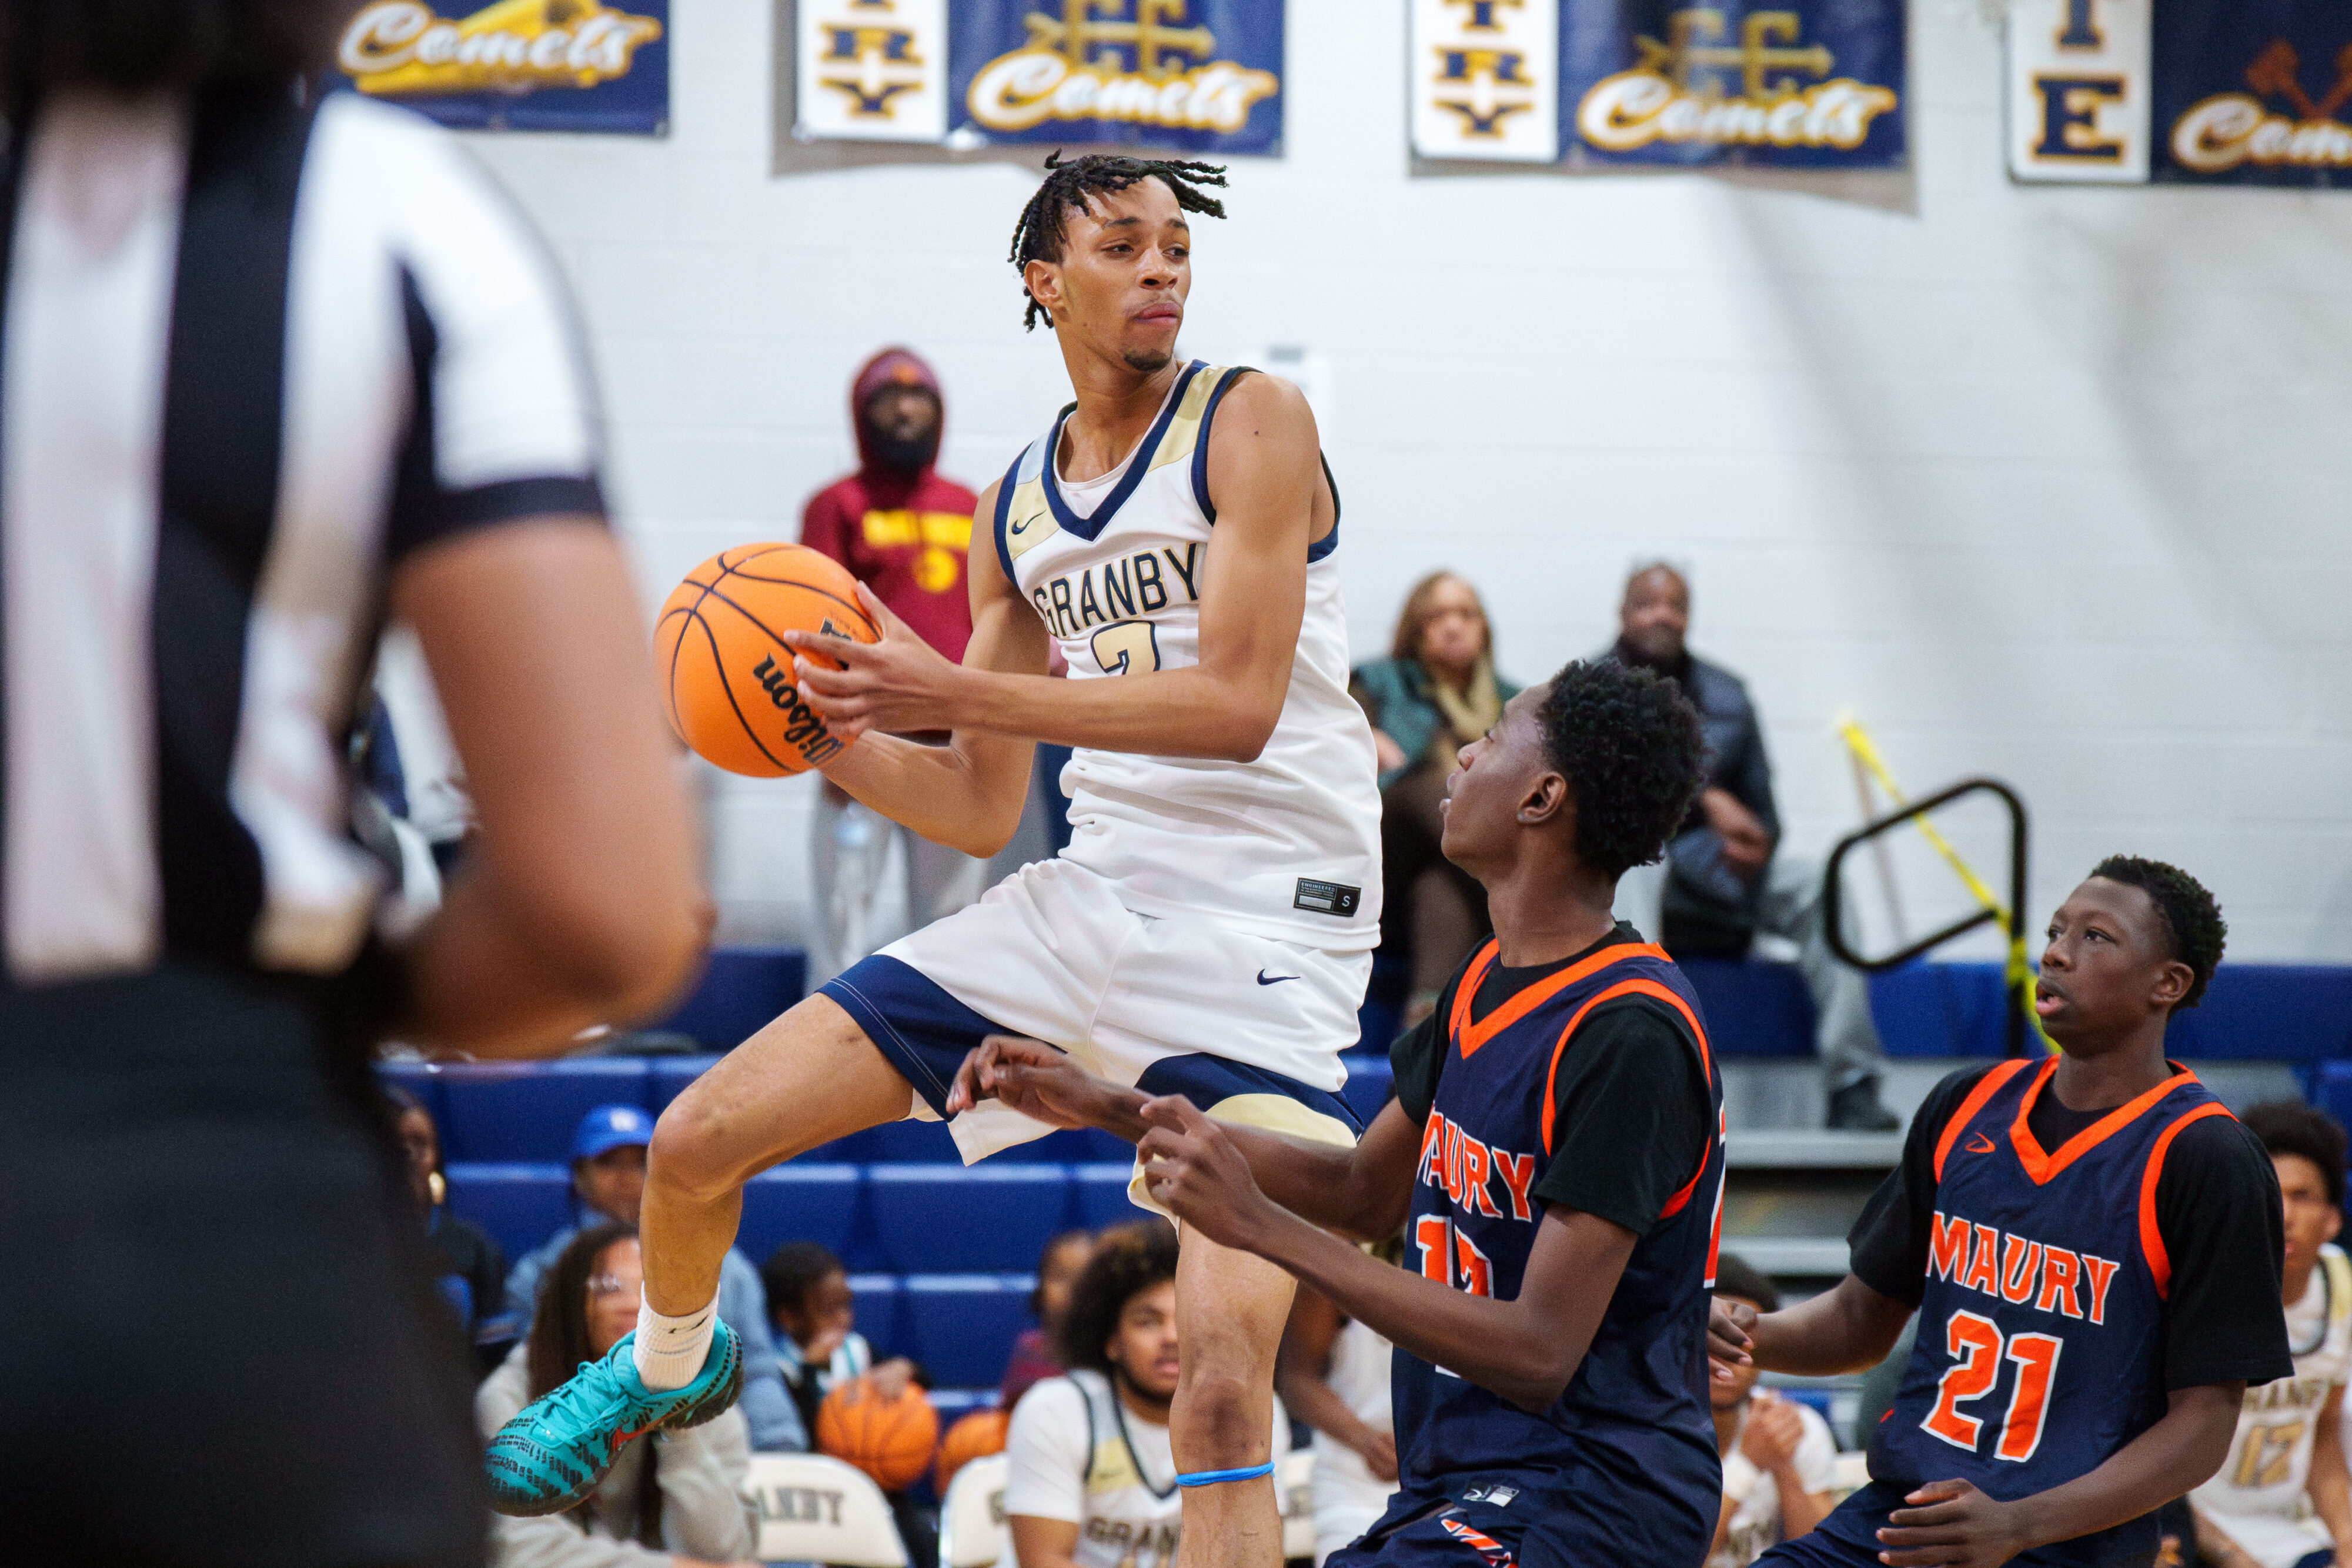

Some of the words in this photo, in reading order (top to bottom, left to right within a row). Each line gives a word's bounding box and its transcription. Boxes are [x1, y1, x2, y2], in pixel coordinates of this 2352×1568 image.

[339, 1, 661, 79] Comets
[820, 0, 924, 119] RY
[968, 48, 1278, 131] Comets
[1577, 69, 1896, 150] Comets
[1033, 542, 1200, 638] GRANBY
[753, 651, 846, 764] Wilson
[1341, 895, 1351, 907] S
[1417, 1099, 1535, 1223] AURY
[1925, 1210, 2120, 1326] MAURY
[1919, 1308, 2063, 1463] 21
